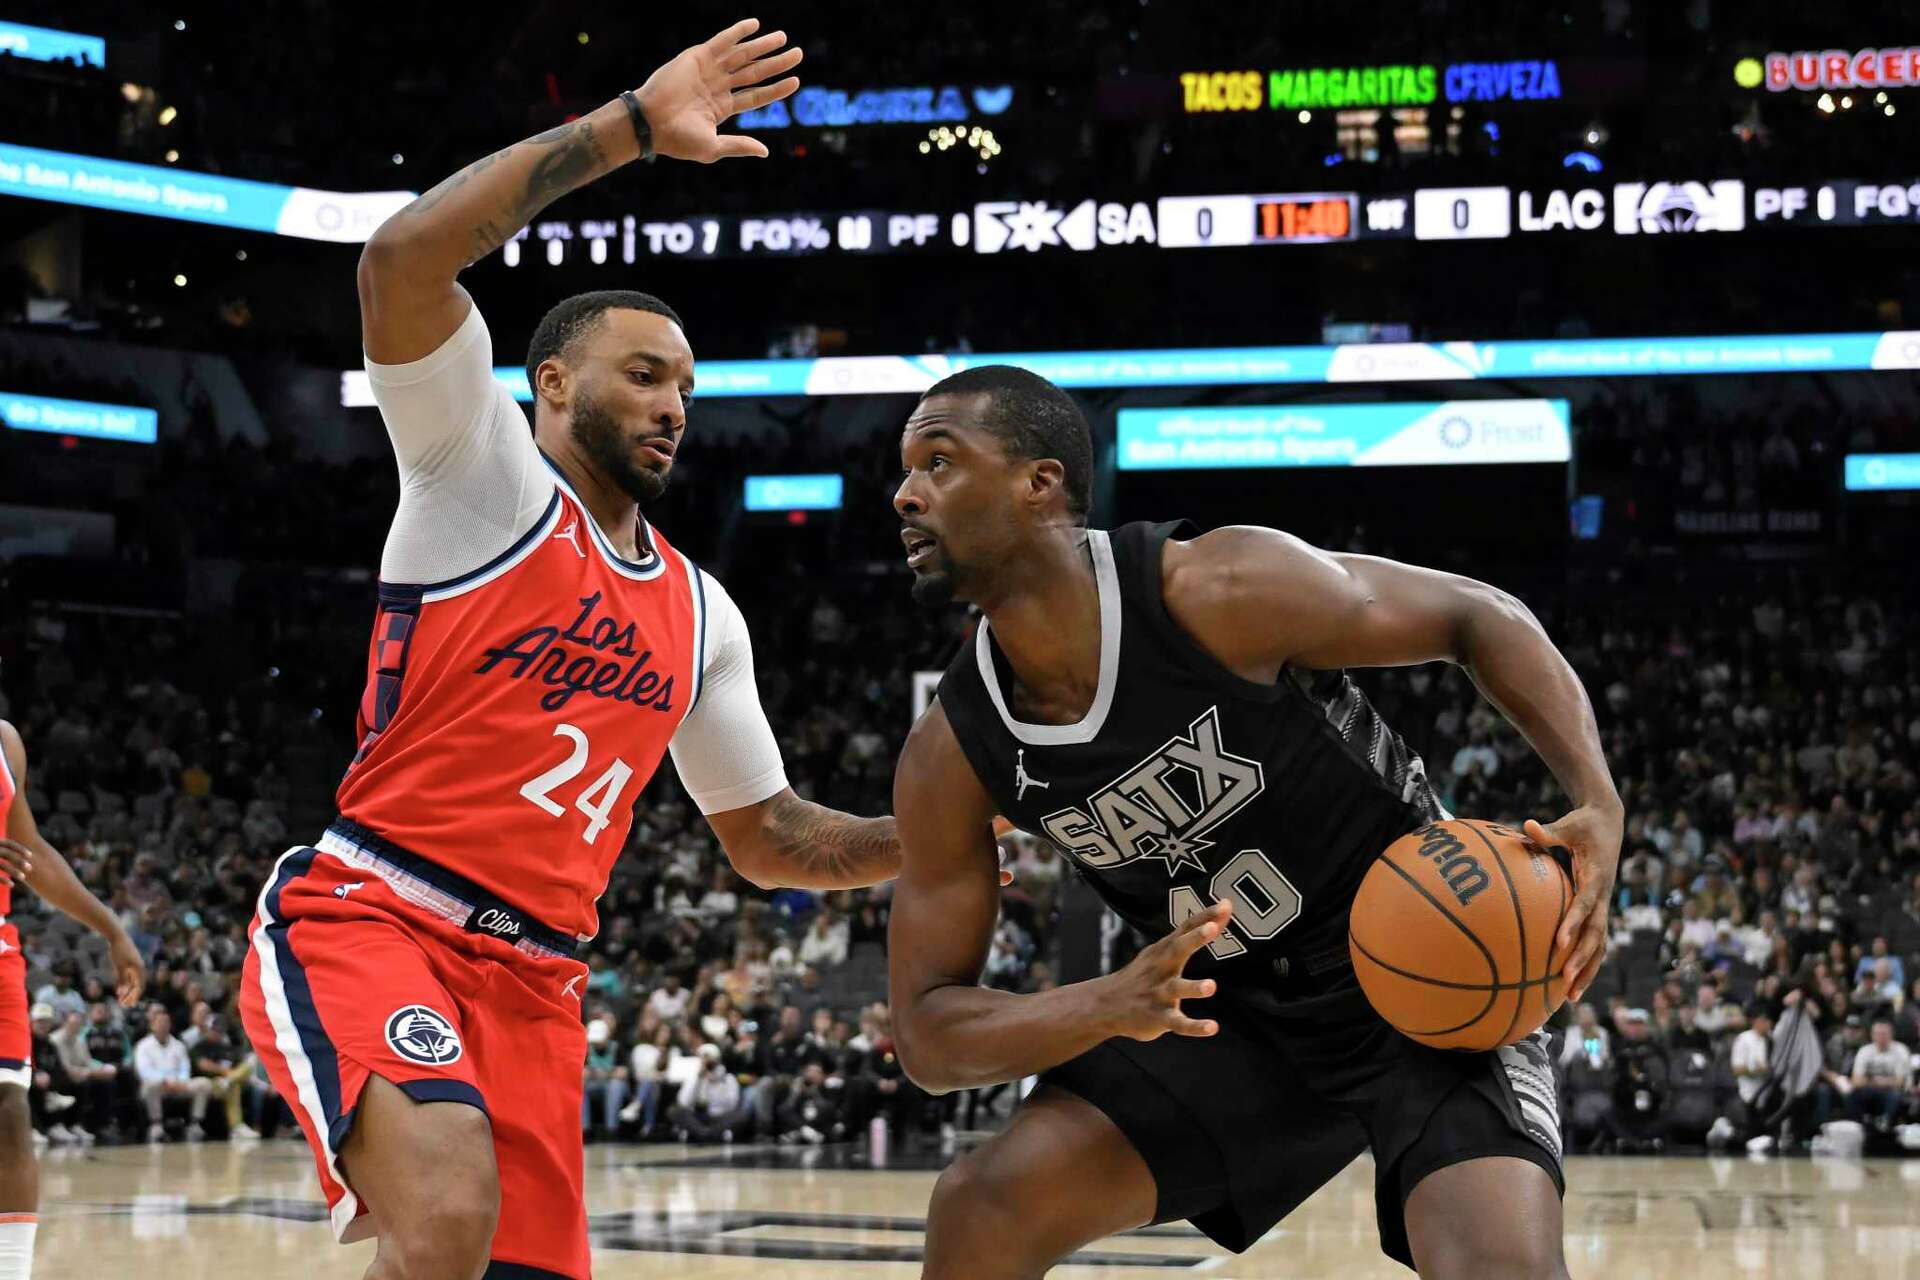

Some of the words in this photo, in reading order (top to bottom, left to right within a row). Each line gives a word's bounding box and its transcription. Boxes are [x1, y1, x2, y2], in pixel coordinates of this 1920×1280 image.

[1180, 71, 1262, 112] TACOS
[1269, 65, 1436, 109] MARGARITAS
[1098, 202, 1157, 245] SA
[1197, 206, 1213, 240] 0
[1453, 197, 1469, 231] 0
[1518, 188, 1606, 232] LAC
[1754, 187, 1808, 221] PF
[642, 222, 695, 254] TO
[888, 213, 939, 247] PF
[561, 590, 637, 658] Los
[472, 625, 674, 713] Angeles
[518, 723, 634, 846] 24
[1040, 705, 1266, 870] SATX
[1412, 823, 1490, 907] Wilso
[477, 908, 520, 935] Clips
